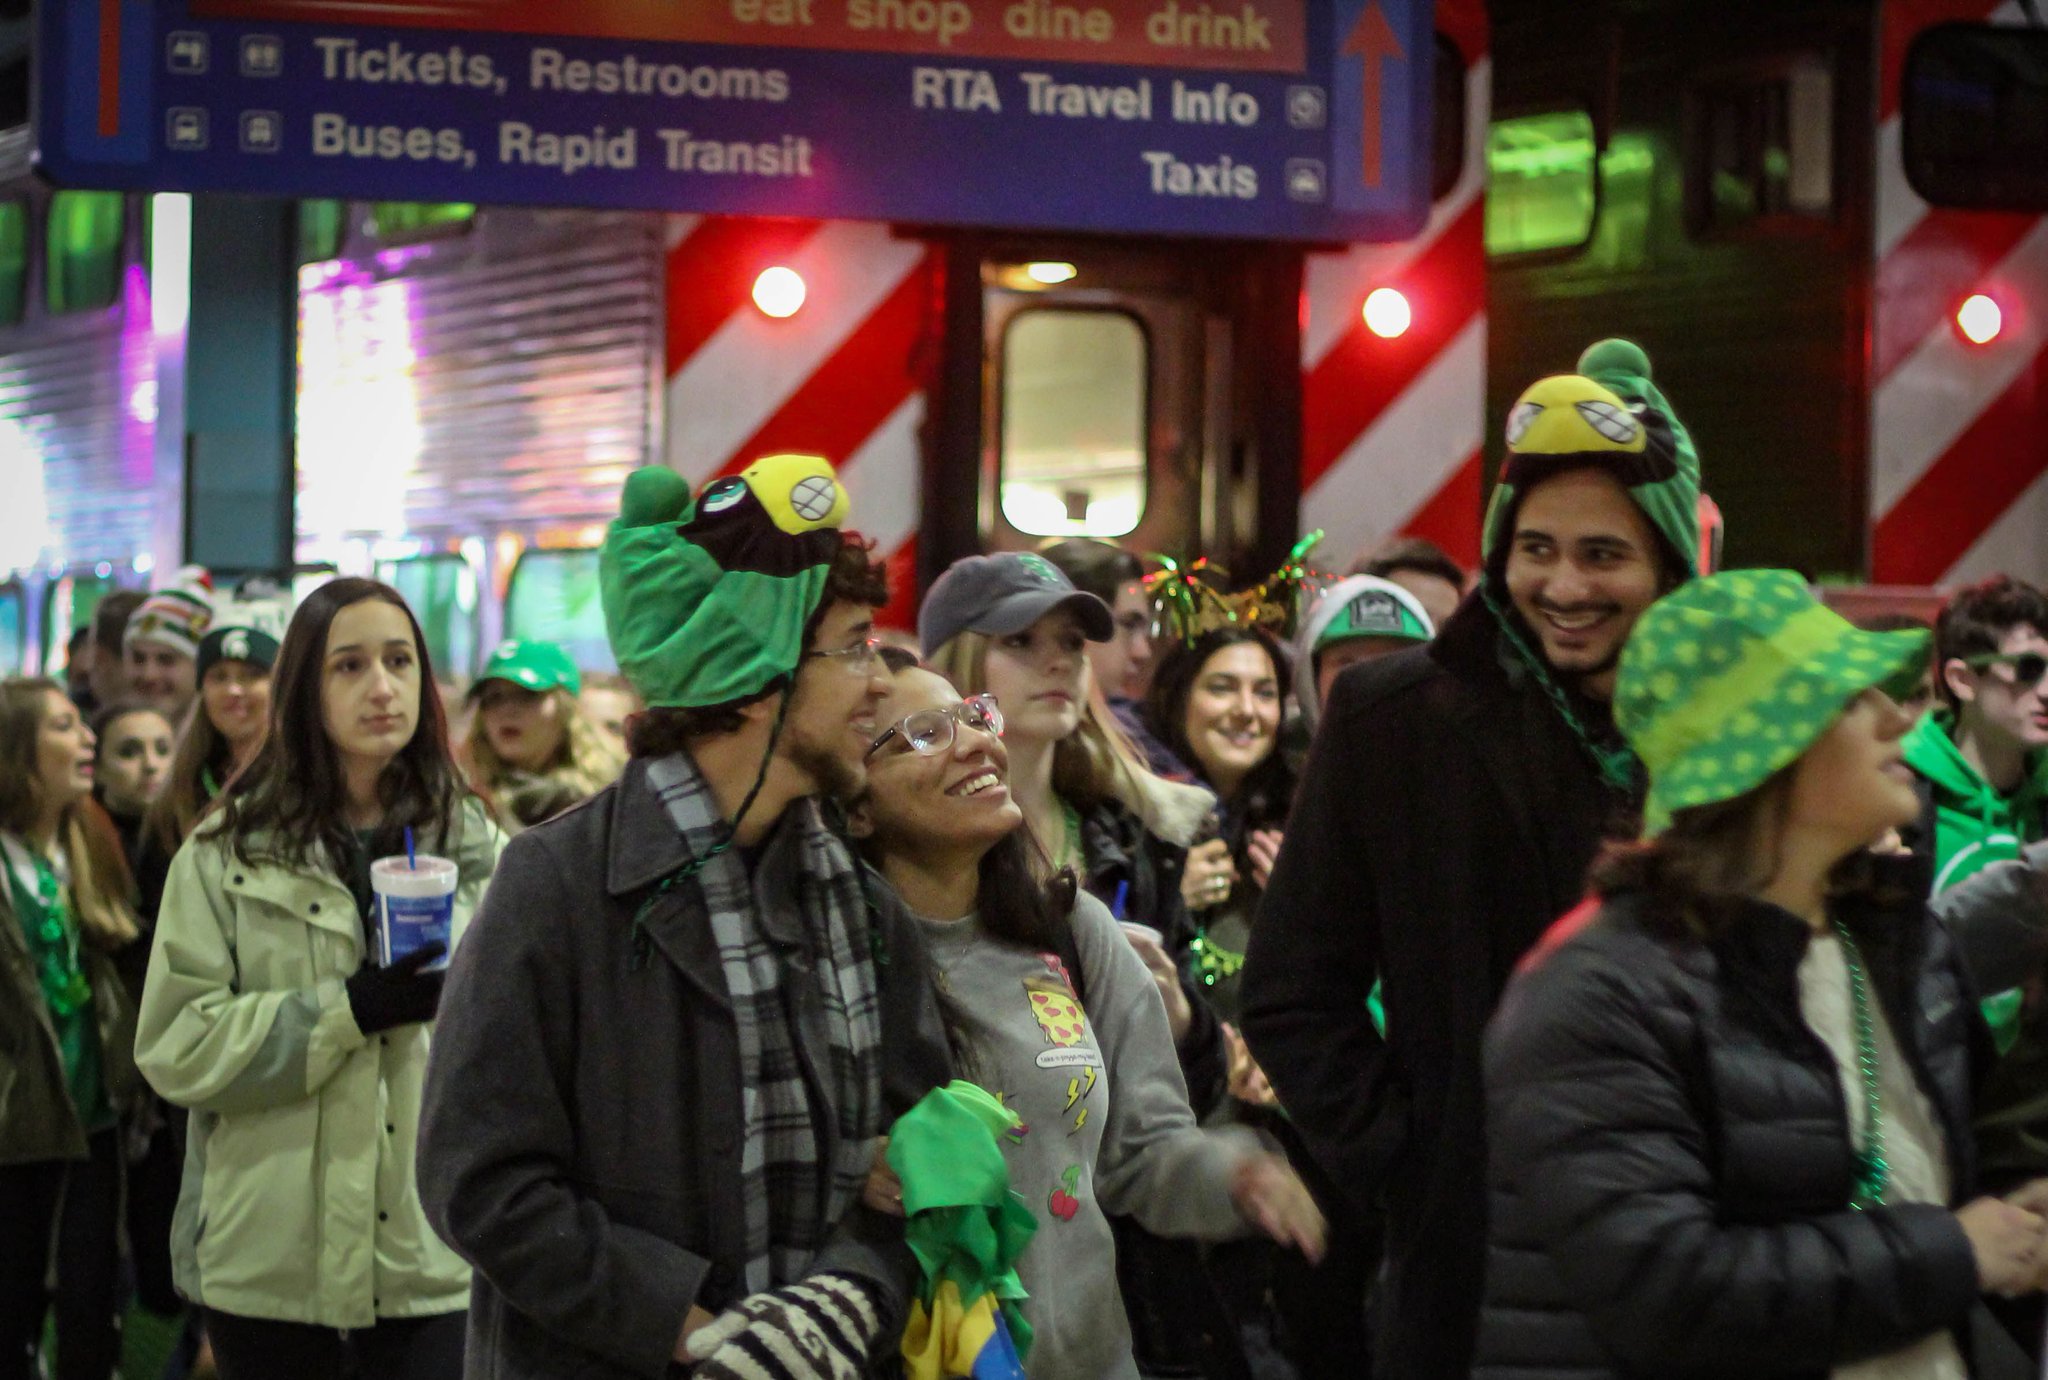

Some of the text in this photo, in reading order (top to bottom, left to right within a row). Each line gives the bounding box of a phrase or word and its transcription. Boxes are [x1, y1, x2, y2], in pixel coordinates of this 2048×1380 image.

[731, 0, 1271, 50] eat shop dine drink
[313, 37, 790, 102] Tickets, Restrooms
[912, 67, 1259, 126] RTA Travel Info
[312, 112, 814, 177] Buses, Rapid Transit
[1142, 151, 1258, 199] Taxis
